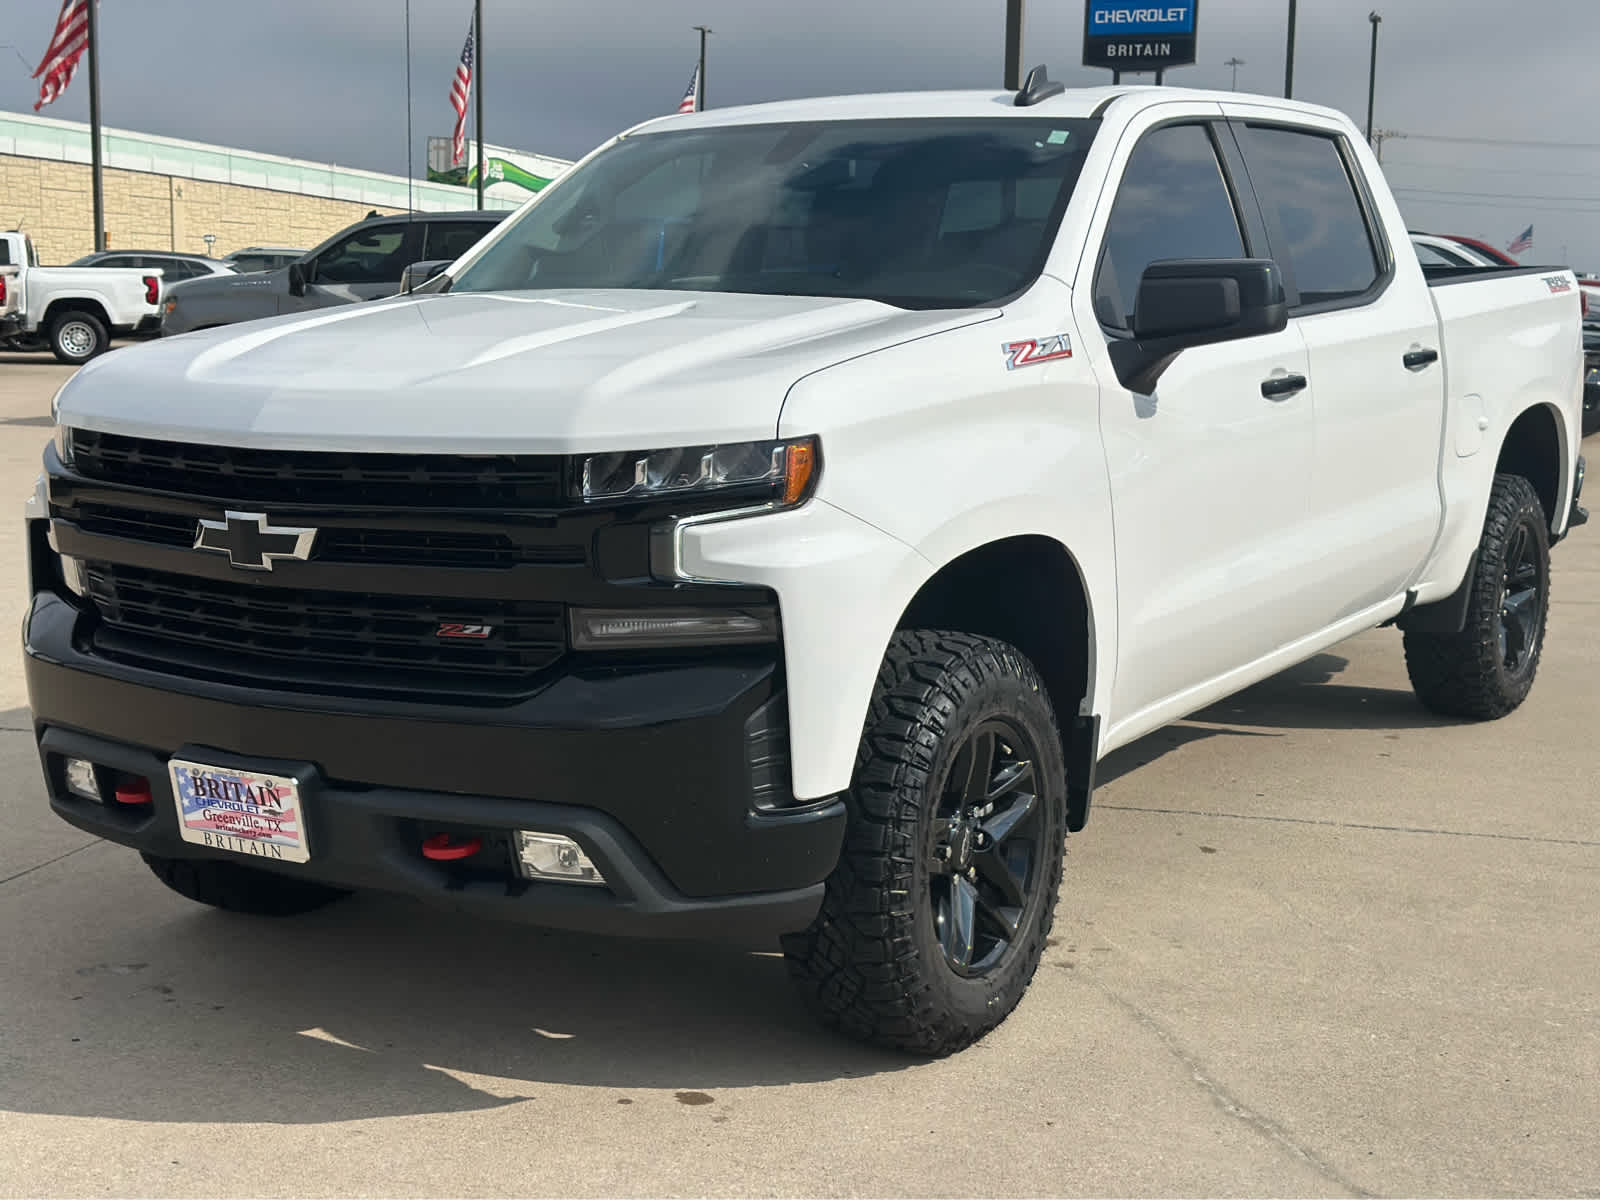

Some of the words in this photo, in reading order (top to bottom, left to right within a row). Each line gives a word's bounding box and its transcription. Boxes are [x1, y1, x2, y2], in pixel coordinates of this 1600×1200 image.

[1095, 8, 1188, 24] CHEVROLET
[1107, 43, 1171, 57] BRITAIN
[1001, 333, 1073, 371] Z71
[436, 623, 492, 639] Z71
[191, 776, 282, 809] BRITAIN
[195, 798, 260, 815] CHEVROLET
[203, 809, 263, 832] Greenville,
[264, 818, 283, 833] TX
[203, 832, 282, 858] BRITAIN
